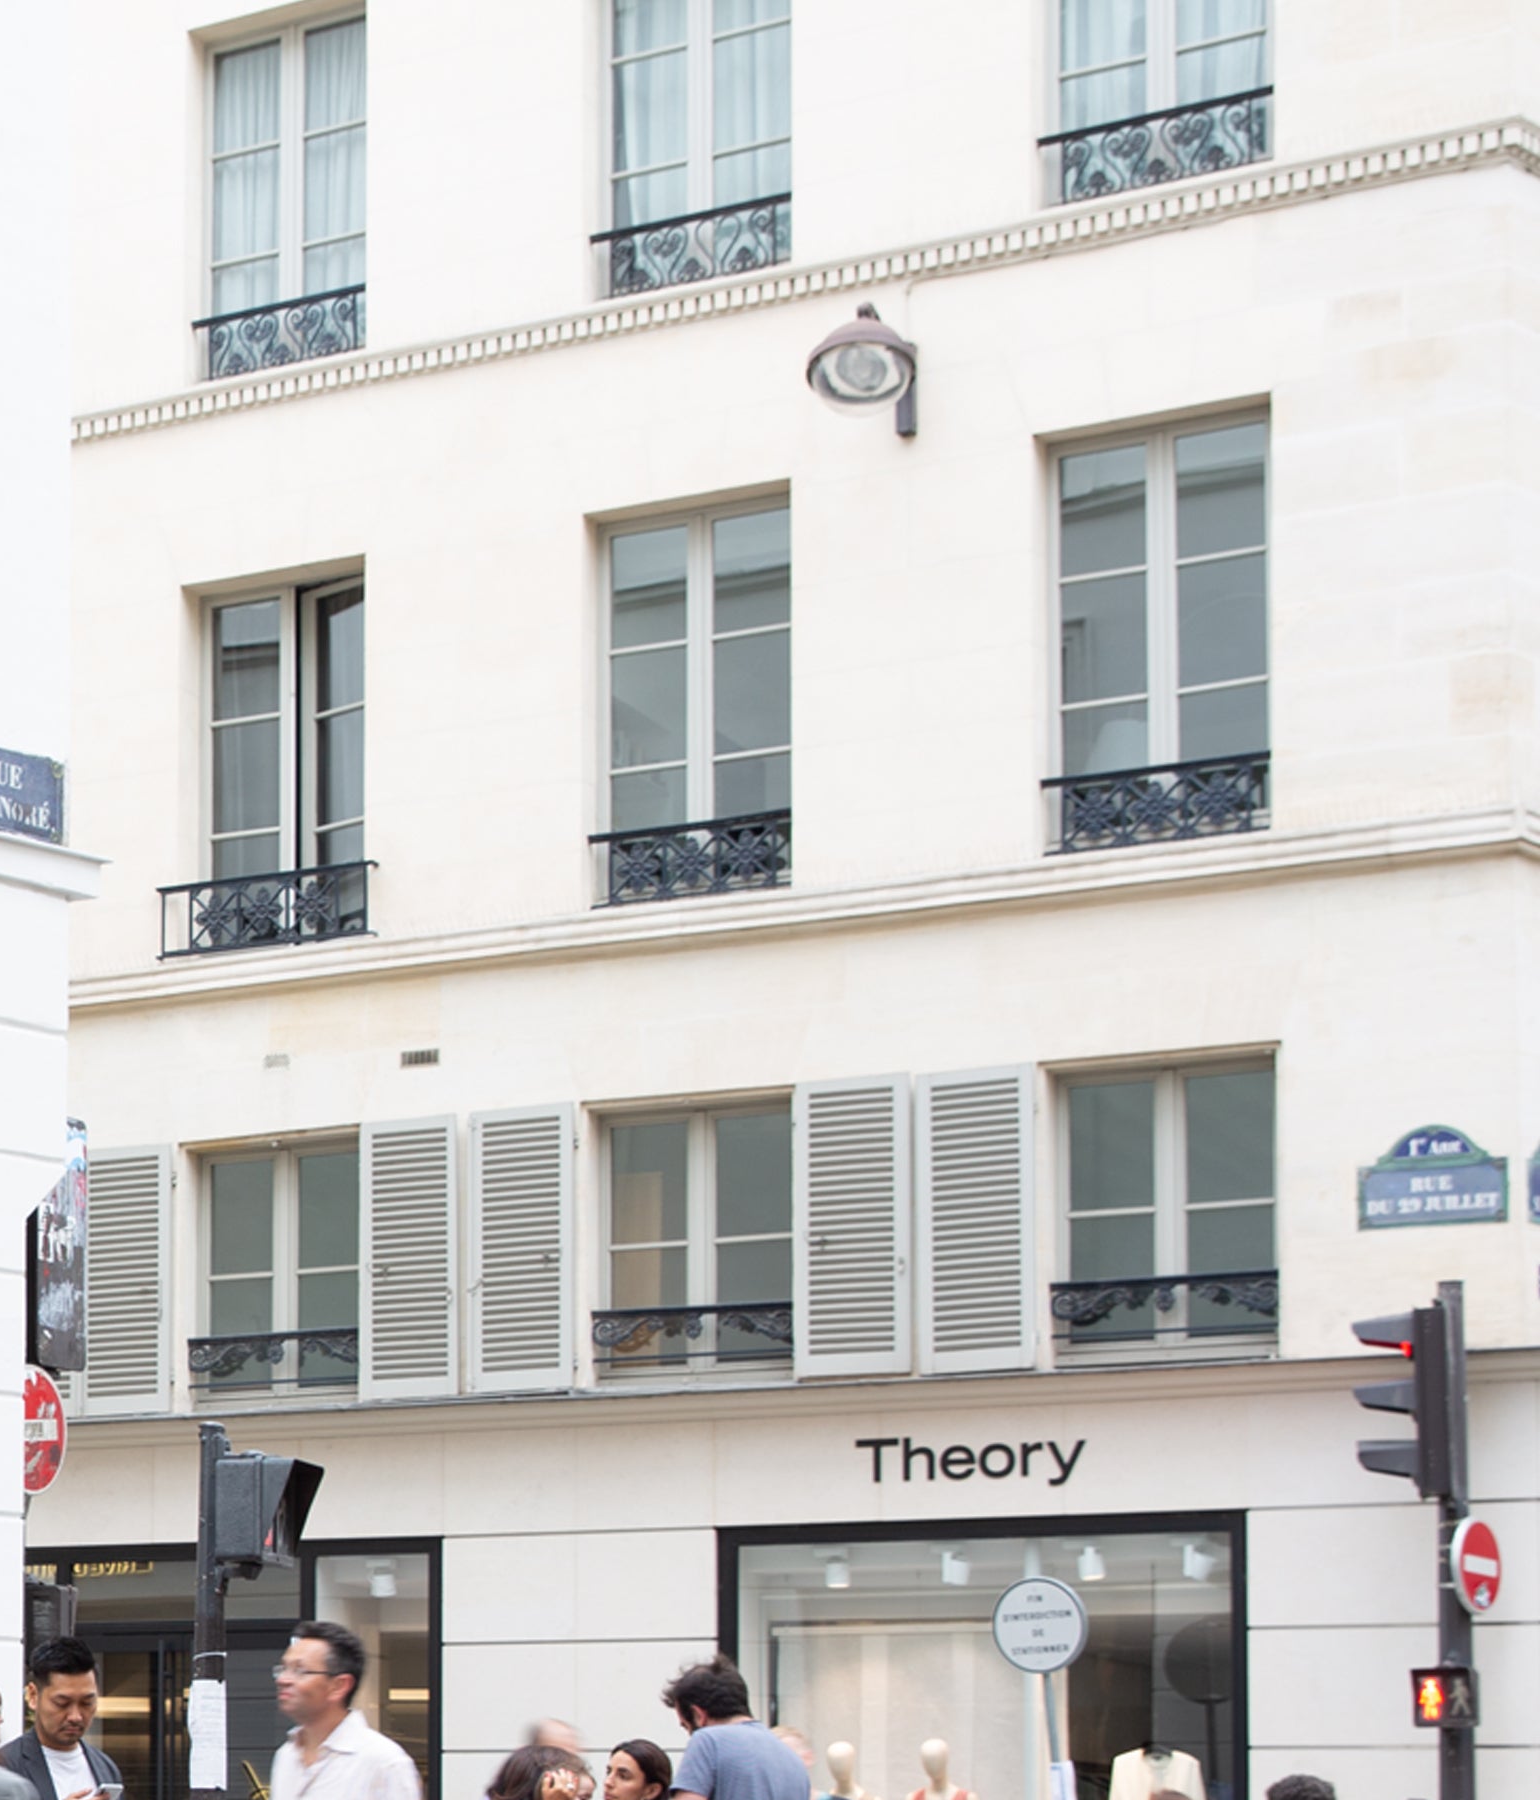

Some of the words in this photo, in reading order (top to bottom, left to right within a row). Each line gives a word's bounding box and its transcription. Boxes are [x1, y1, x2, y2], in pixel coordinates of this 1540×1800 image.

[1410, 1174, 1454, 1194] RUE
[1366, 1200, 1391, 1216] DU
[1397, 1197, 1422, 1214] 29
[1424, 1192, 1499, 1212] JUILLET
[855, 1437, 1086, 1487] Theory
